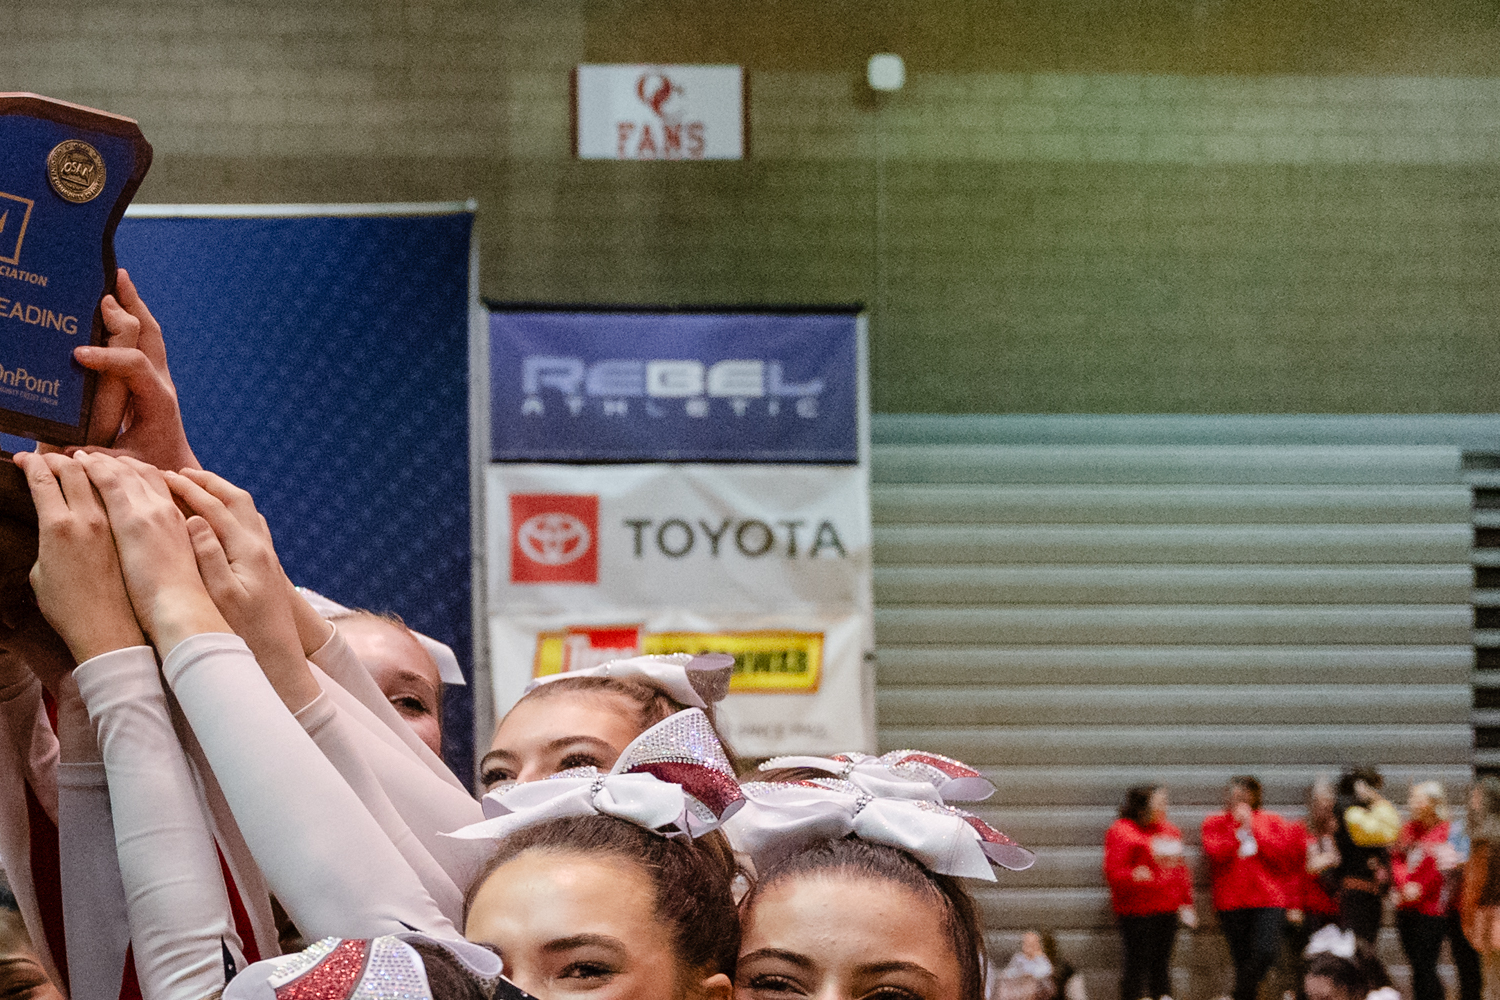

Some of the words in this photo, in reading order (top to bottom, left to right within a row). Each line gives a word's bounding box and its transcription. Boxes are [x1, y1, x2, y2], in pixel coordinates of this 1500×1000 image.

[616, 121, 706, 160] FANS
[521, 355, 824, 398] REBEL
[622, 518, 847, 559] TOYOTA
